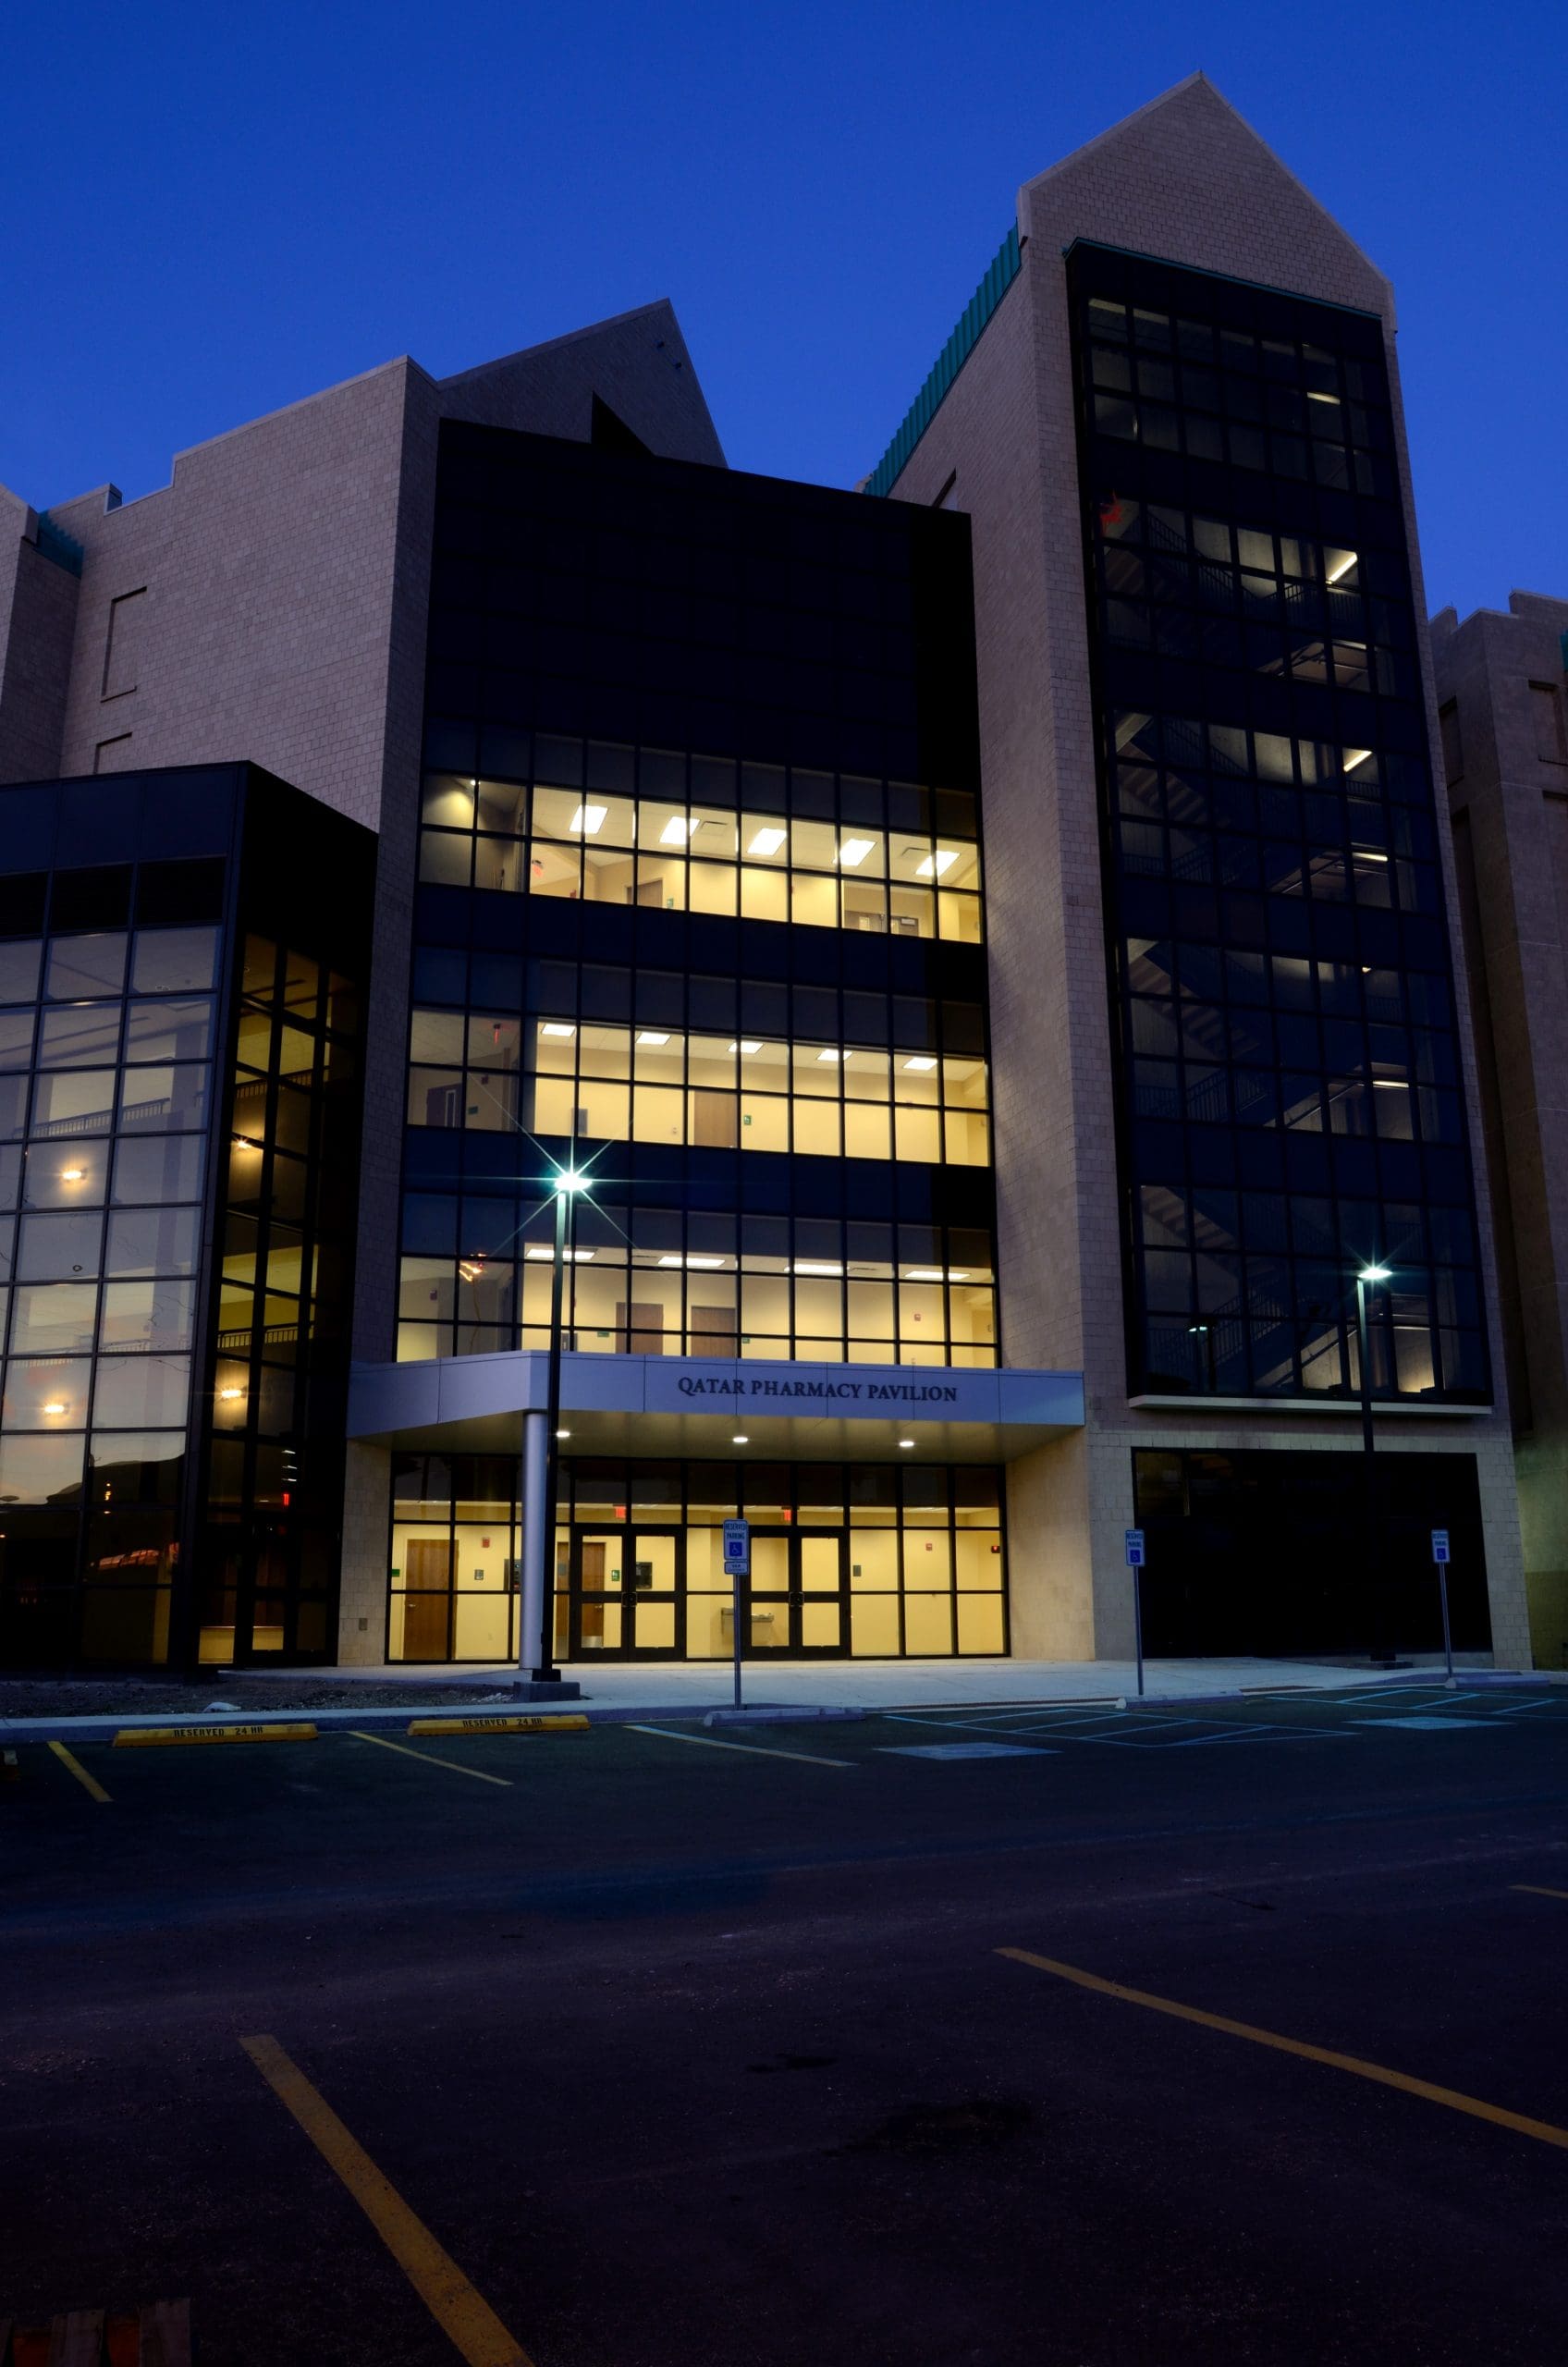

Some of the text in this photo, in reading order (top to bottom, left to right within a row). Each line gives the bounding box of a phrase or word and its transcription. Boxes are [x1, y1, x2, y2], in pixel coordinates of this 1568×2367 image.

[678, 1376, 957, 1402] QATAR PHARMACY PAVILION
[462, 1718, 508, 1728] RESERVED
[174, 1725, 263, 1737] RESERVED 24 HR
